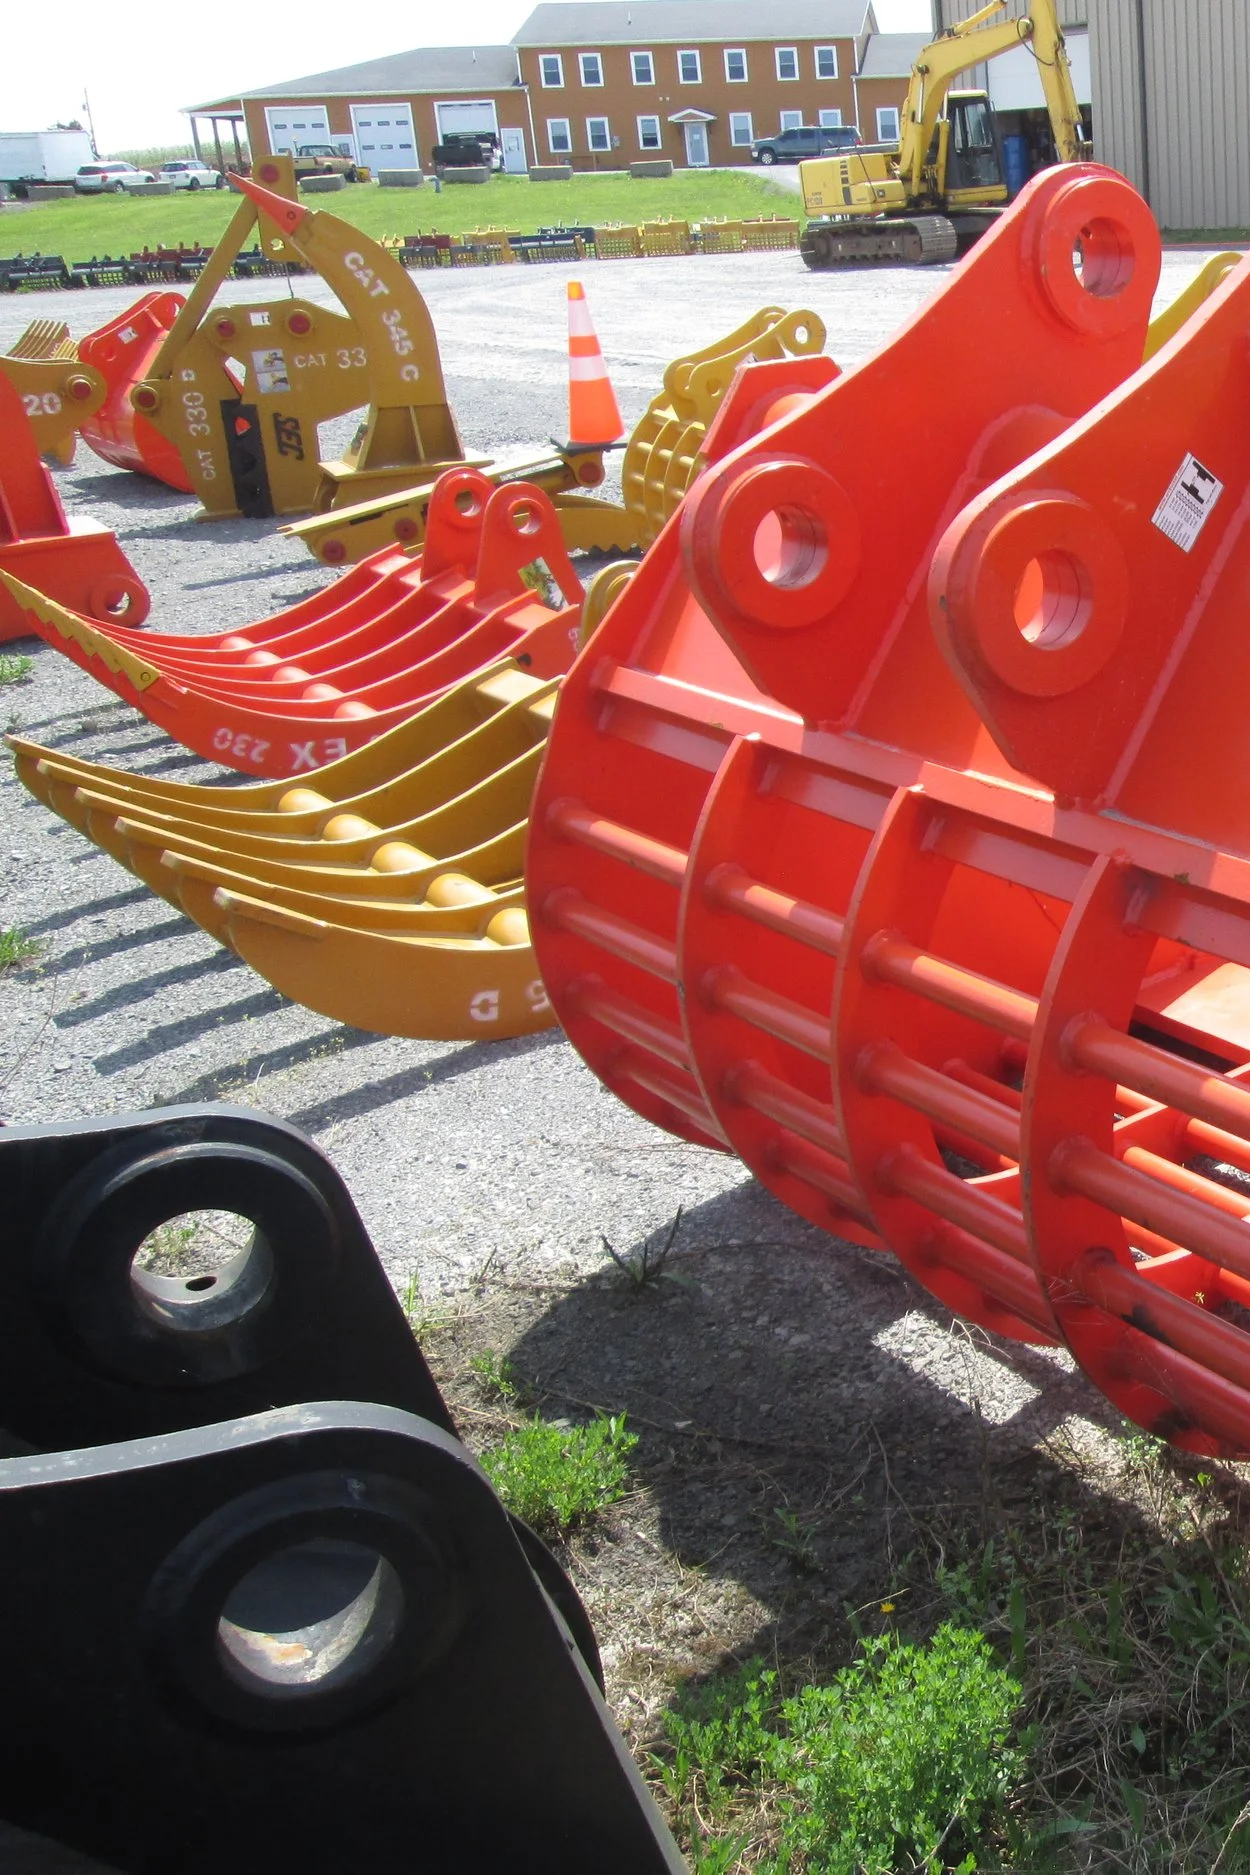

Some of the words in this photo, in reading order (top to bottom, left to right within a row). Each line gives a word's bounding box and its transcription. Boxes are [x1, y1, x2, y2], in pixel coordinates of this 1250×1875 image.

[344, 251, 390, 297] CAT
[383, 308, 415, 356] 345
[401, 364, 419, 382] C
[295, 353, 327, 368] CAT
[22, 392, 62, 416] 20
[182, 392, 211, 436] 330
[196, 449, 216, 480] CAT
[213, 727, 271, 764] 230
[290, 737, 348, 771] EX
[470, 989, 499, 1021] D
